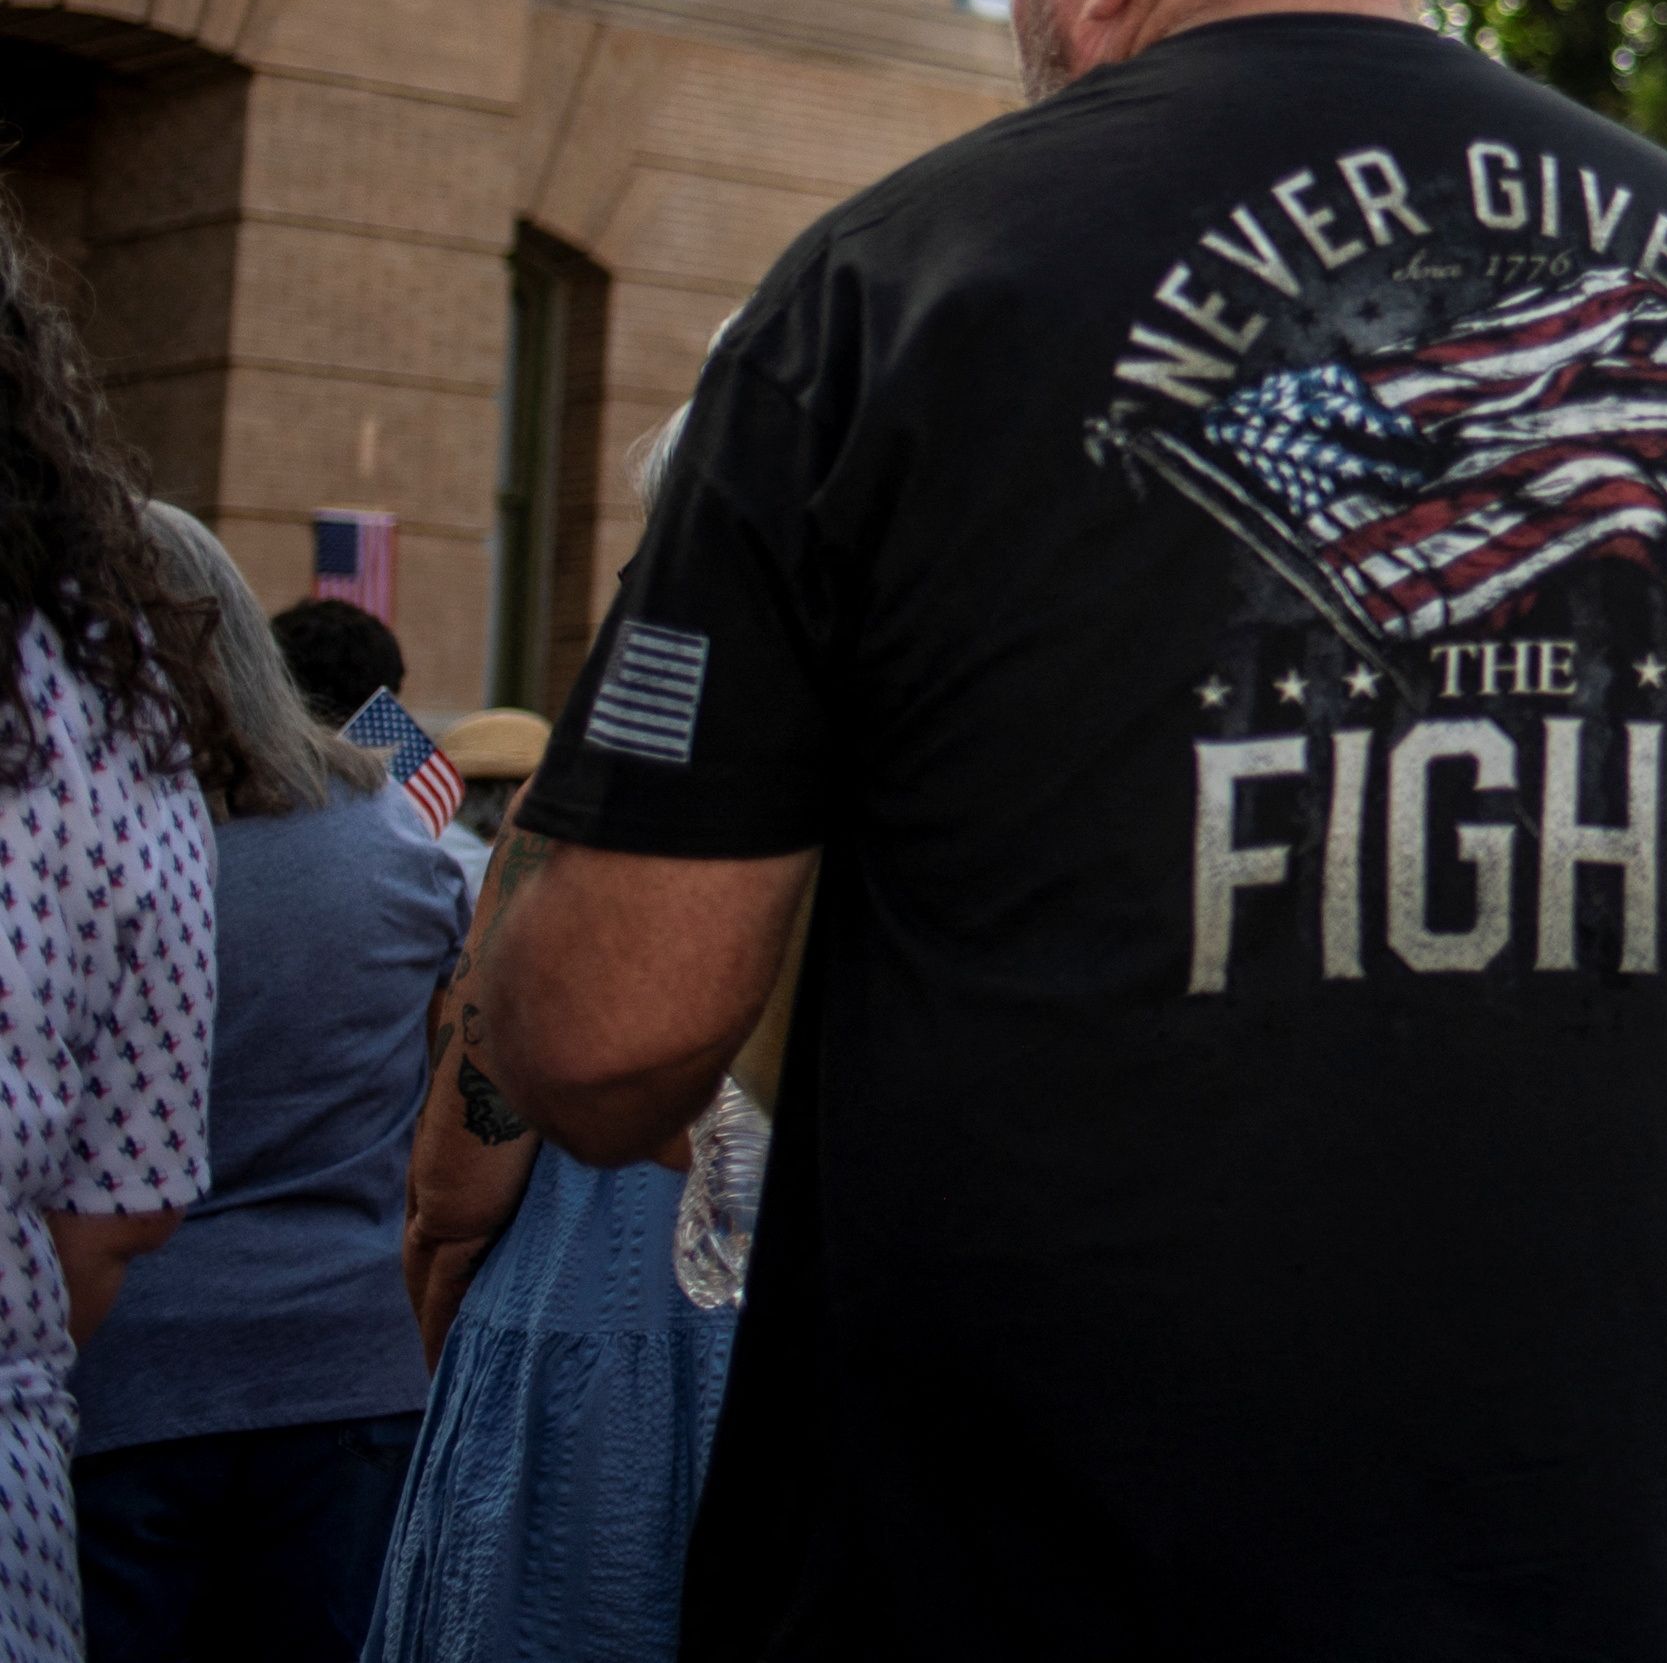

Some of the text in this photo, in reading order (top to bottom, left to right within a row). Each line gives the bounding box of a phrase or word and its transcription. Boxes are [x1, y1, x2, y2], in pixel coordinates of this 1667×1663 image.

[1113, 148, 1432, 409] NEVER
[1486, 247, 1575, 284] 1776
[1430, 639, 1578, 698] THE
